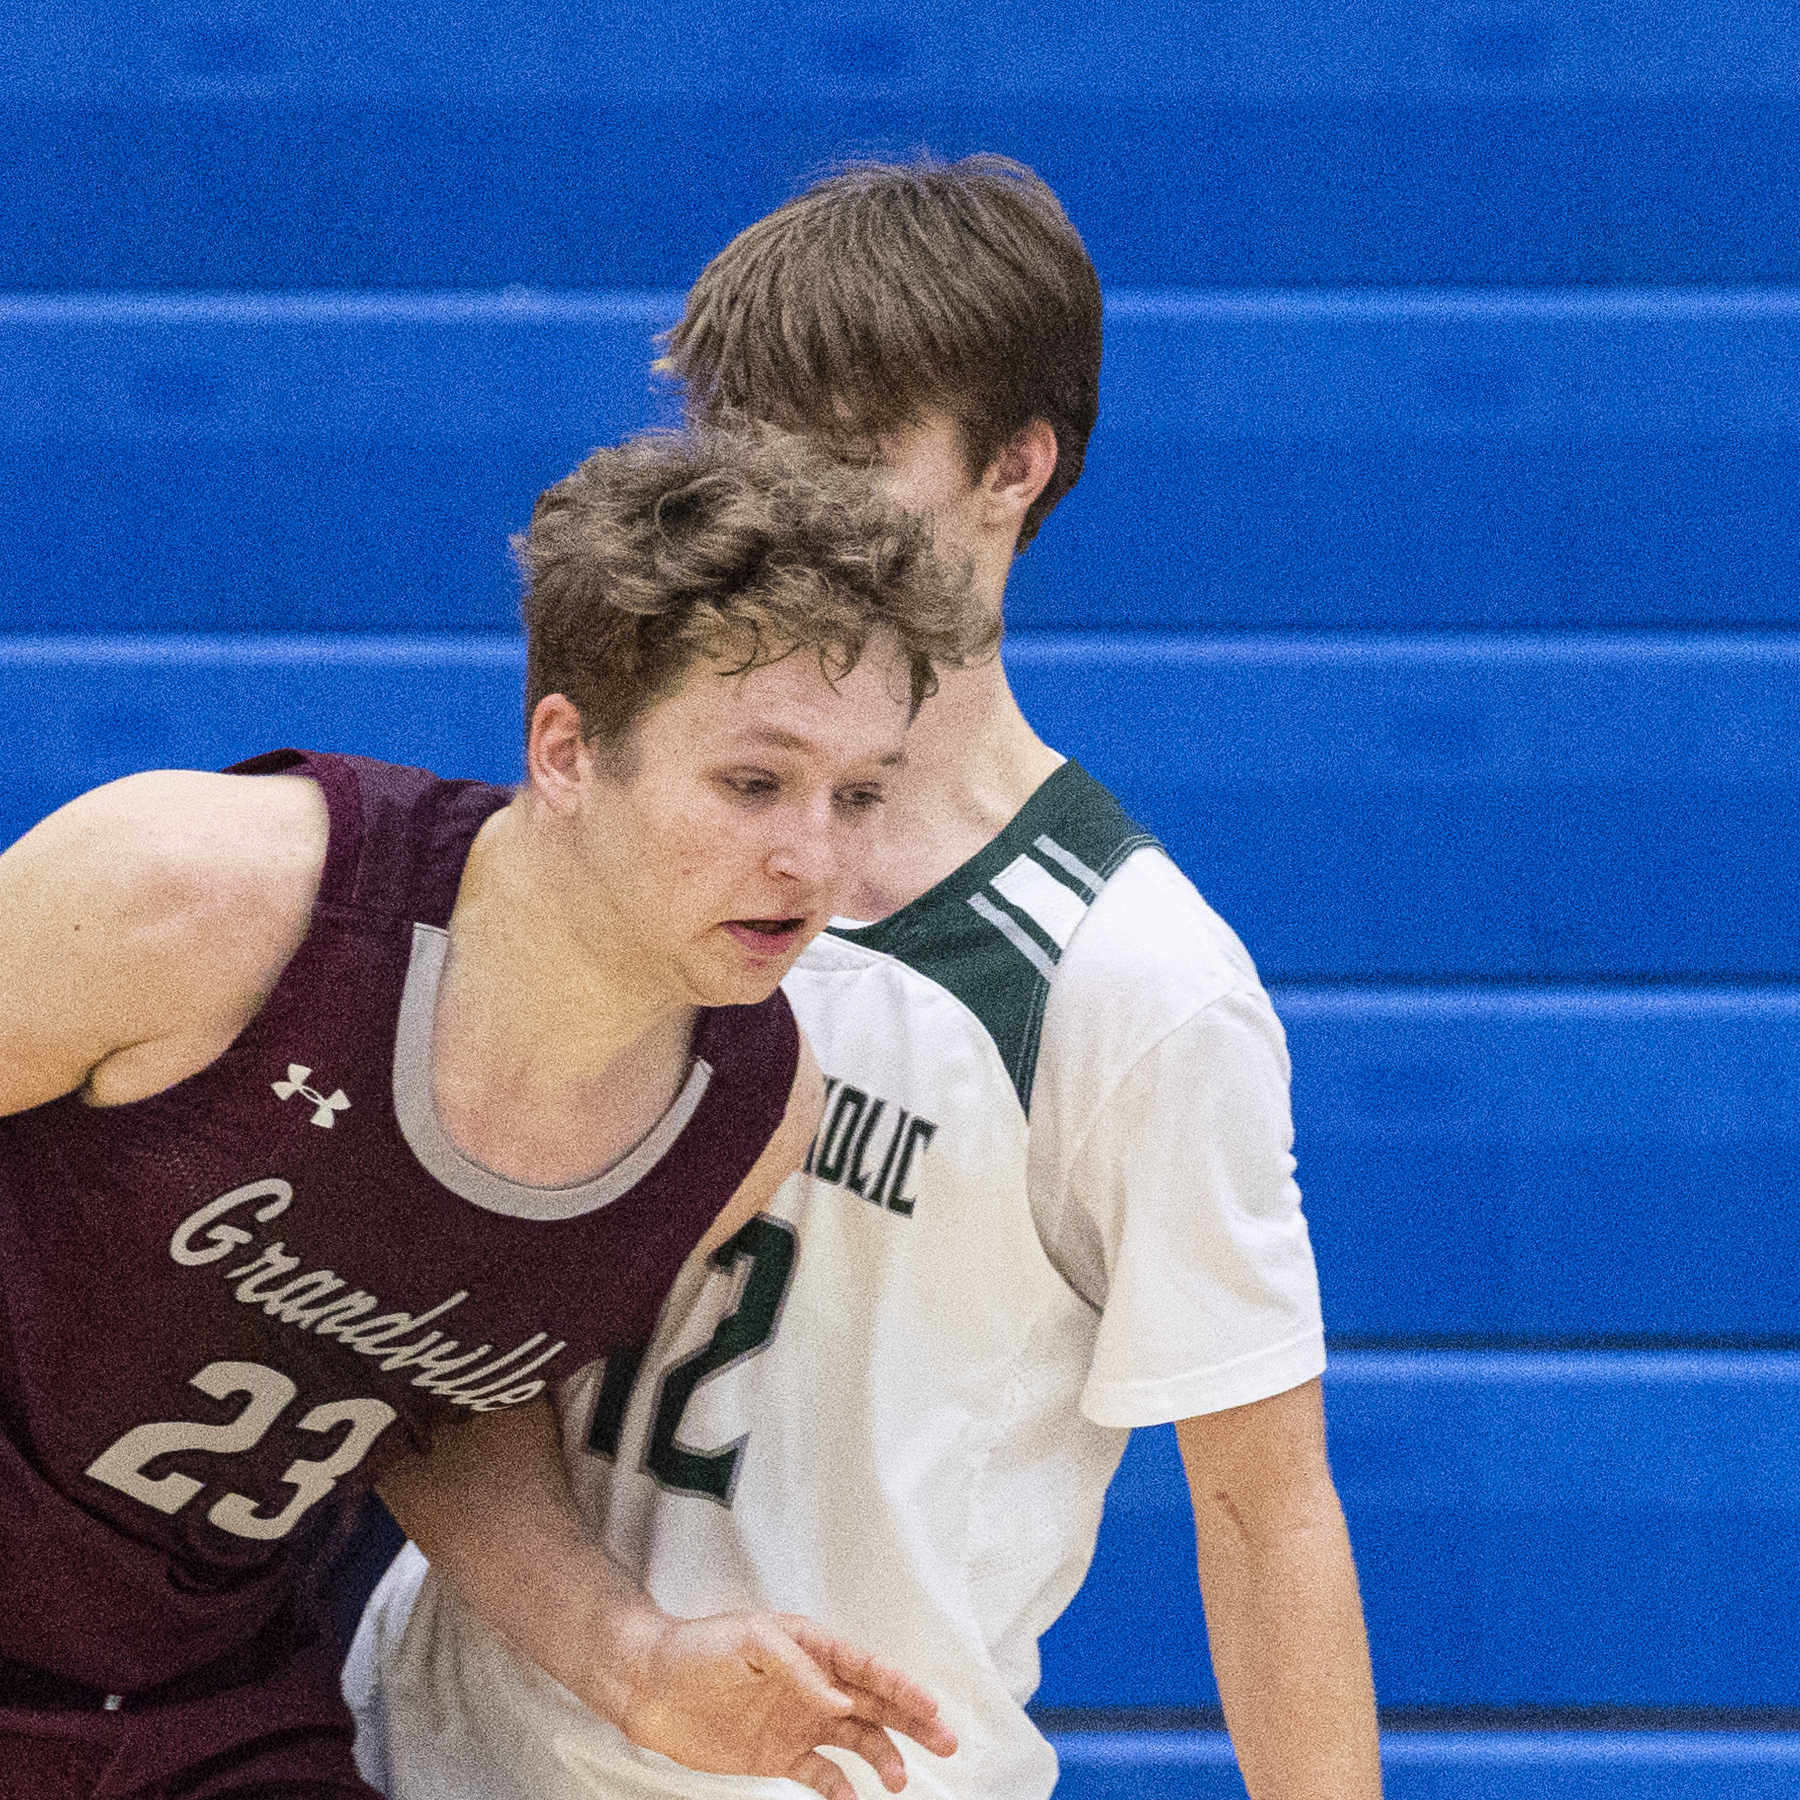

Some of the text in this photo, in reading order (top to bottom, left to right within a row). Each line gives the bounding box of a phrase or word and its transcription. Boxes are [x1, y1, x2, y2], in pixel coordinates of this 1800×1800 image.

[803, 1073, 939, 1219] OLIC
[170, 1177, 567, 1411] Grandville
[85, 1360, 398, 1541] 23
